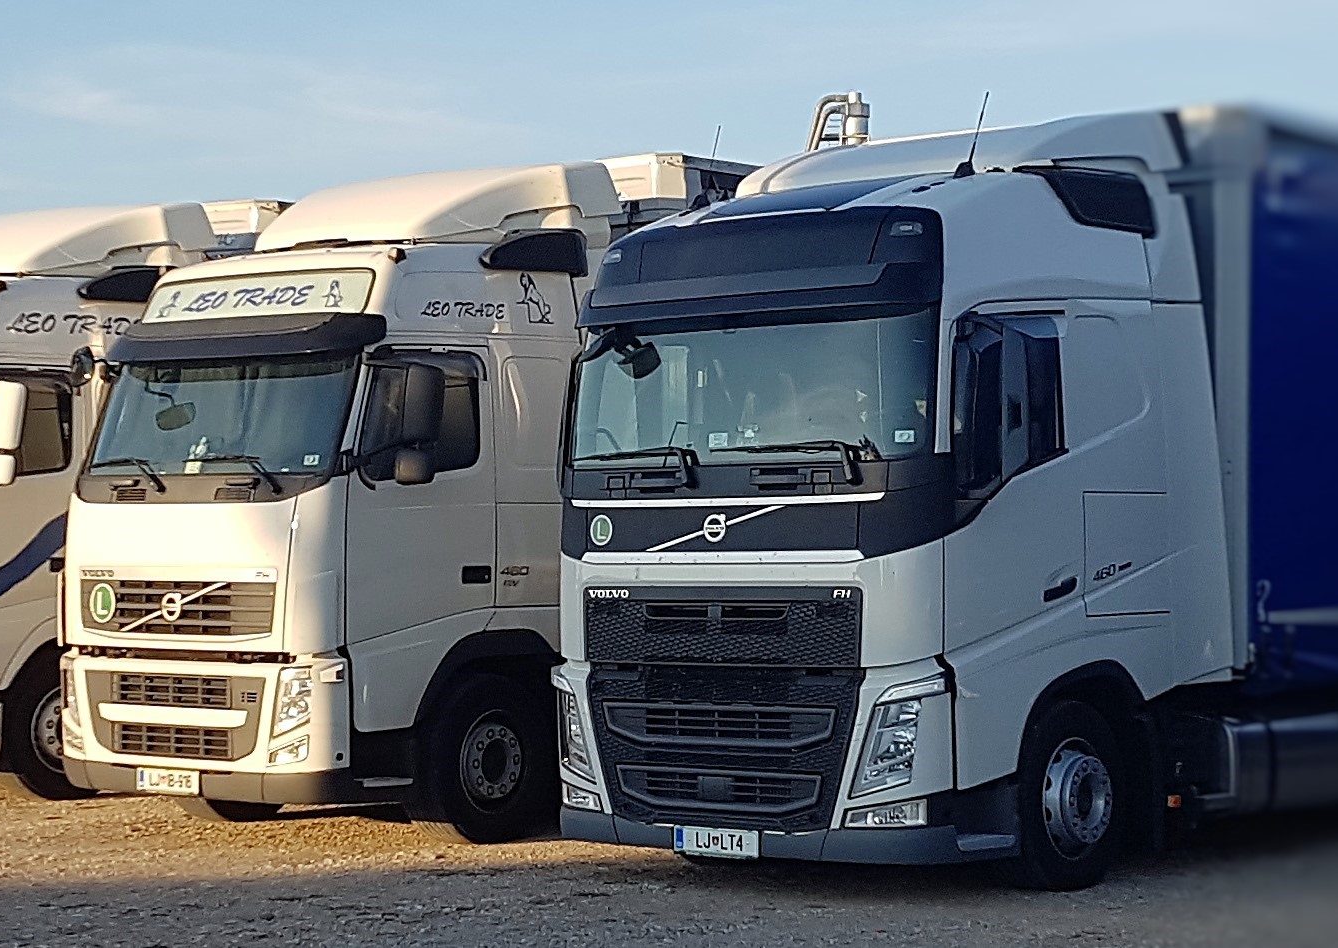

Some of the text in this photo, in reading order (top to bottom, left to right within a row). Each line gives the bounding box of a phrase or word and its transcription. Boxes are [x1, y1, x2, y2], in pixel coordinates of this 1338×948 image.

[181, 285, 315, 313] LEO TRADE
[421, 301, 505, 320] LEO TRADE
[6, 312, 142, 336] LEO TRAD
[1093, 564, 1116, 581] 460
[588, 589, 630, 599] VOLVO
[833, 589, 852, 599] FH
[695, 831, 711, 849] LJ
